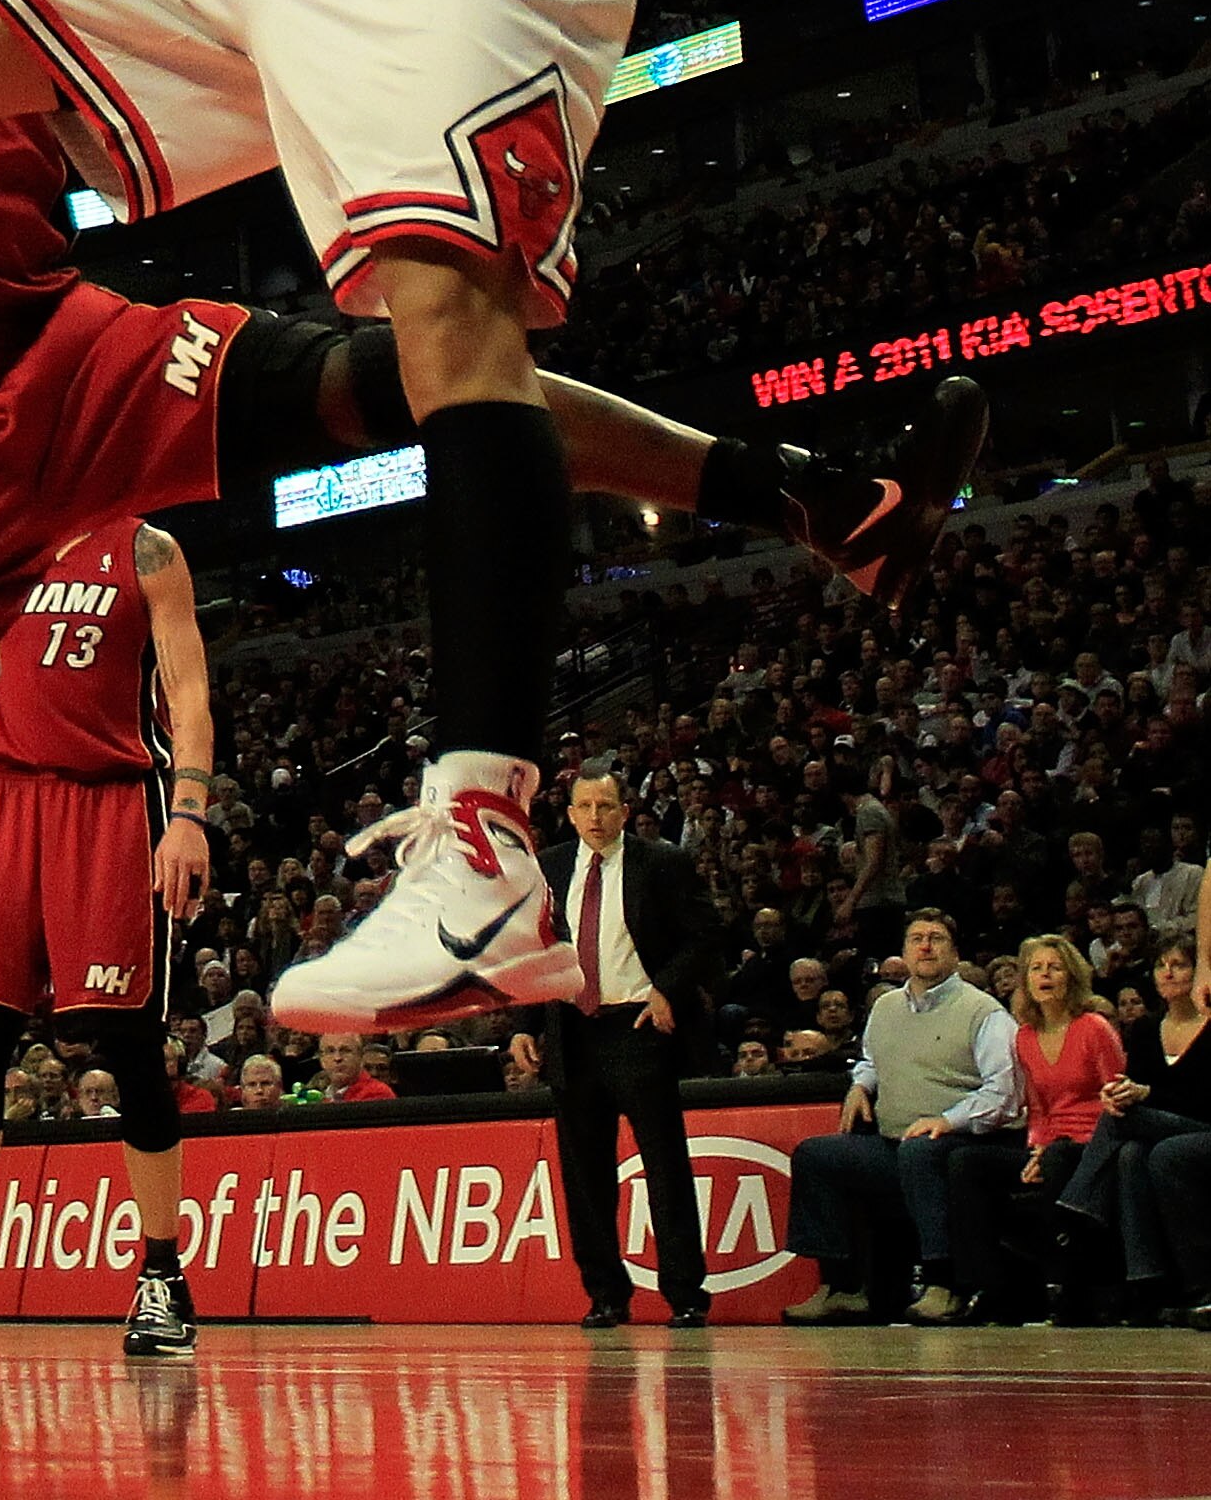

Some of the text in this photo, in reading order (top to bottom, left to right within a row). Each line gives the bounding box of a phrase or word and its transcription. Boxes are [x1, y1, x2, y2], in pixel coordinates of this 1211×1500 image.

[751, 357, 826, 407] WIN
[833, 351, 864, 390] A
[870, 328, 953, 382] 2011
[960, 311, 1031, 359] KIA
[22, 581, 119, 617] IAMI
[40, 621, 104, 669] 13
[178, 1173, 240, 1270] of
[251, 1169, 367, 1267] the
[389, 1159, 562, 1266] NBA
